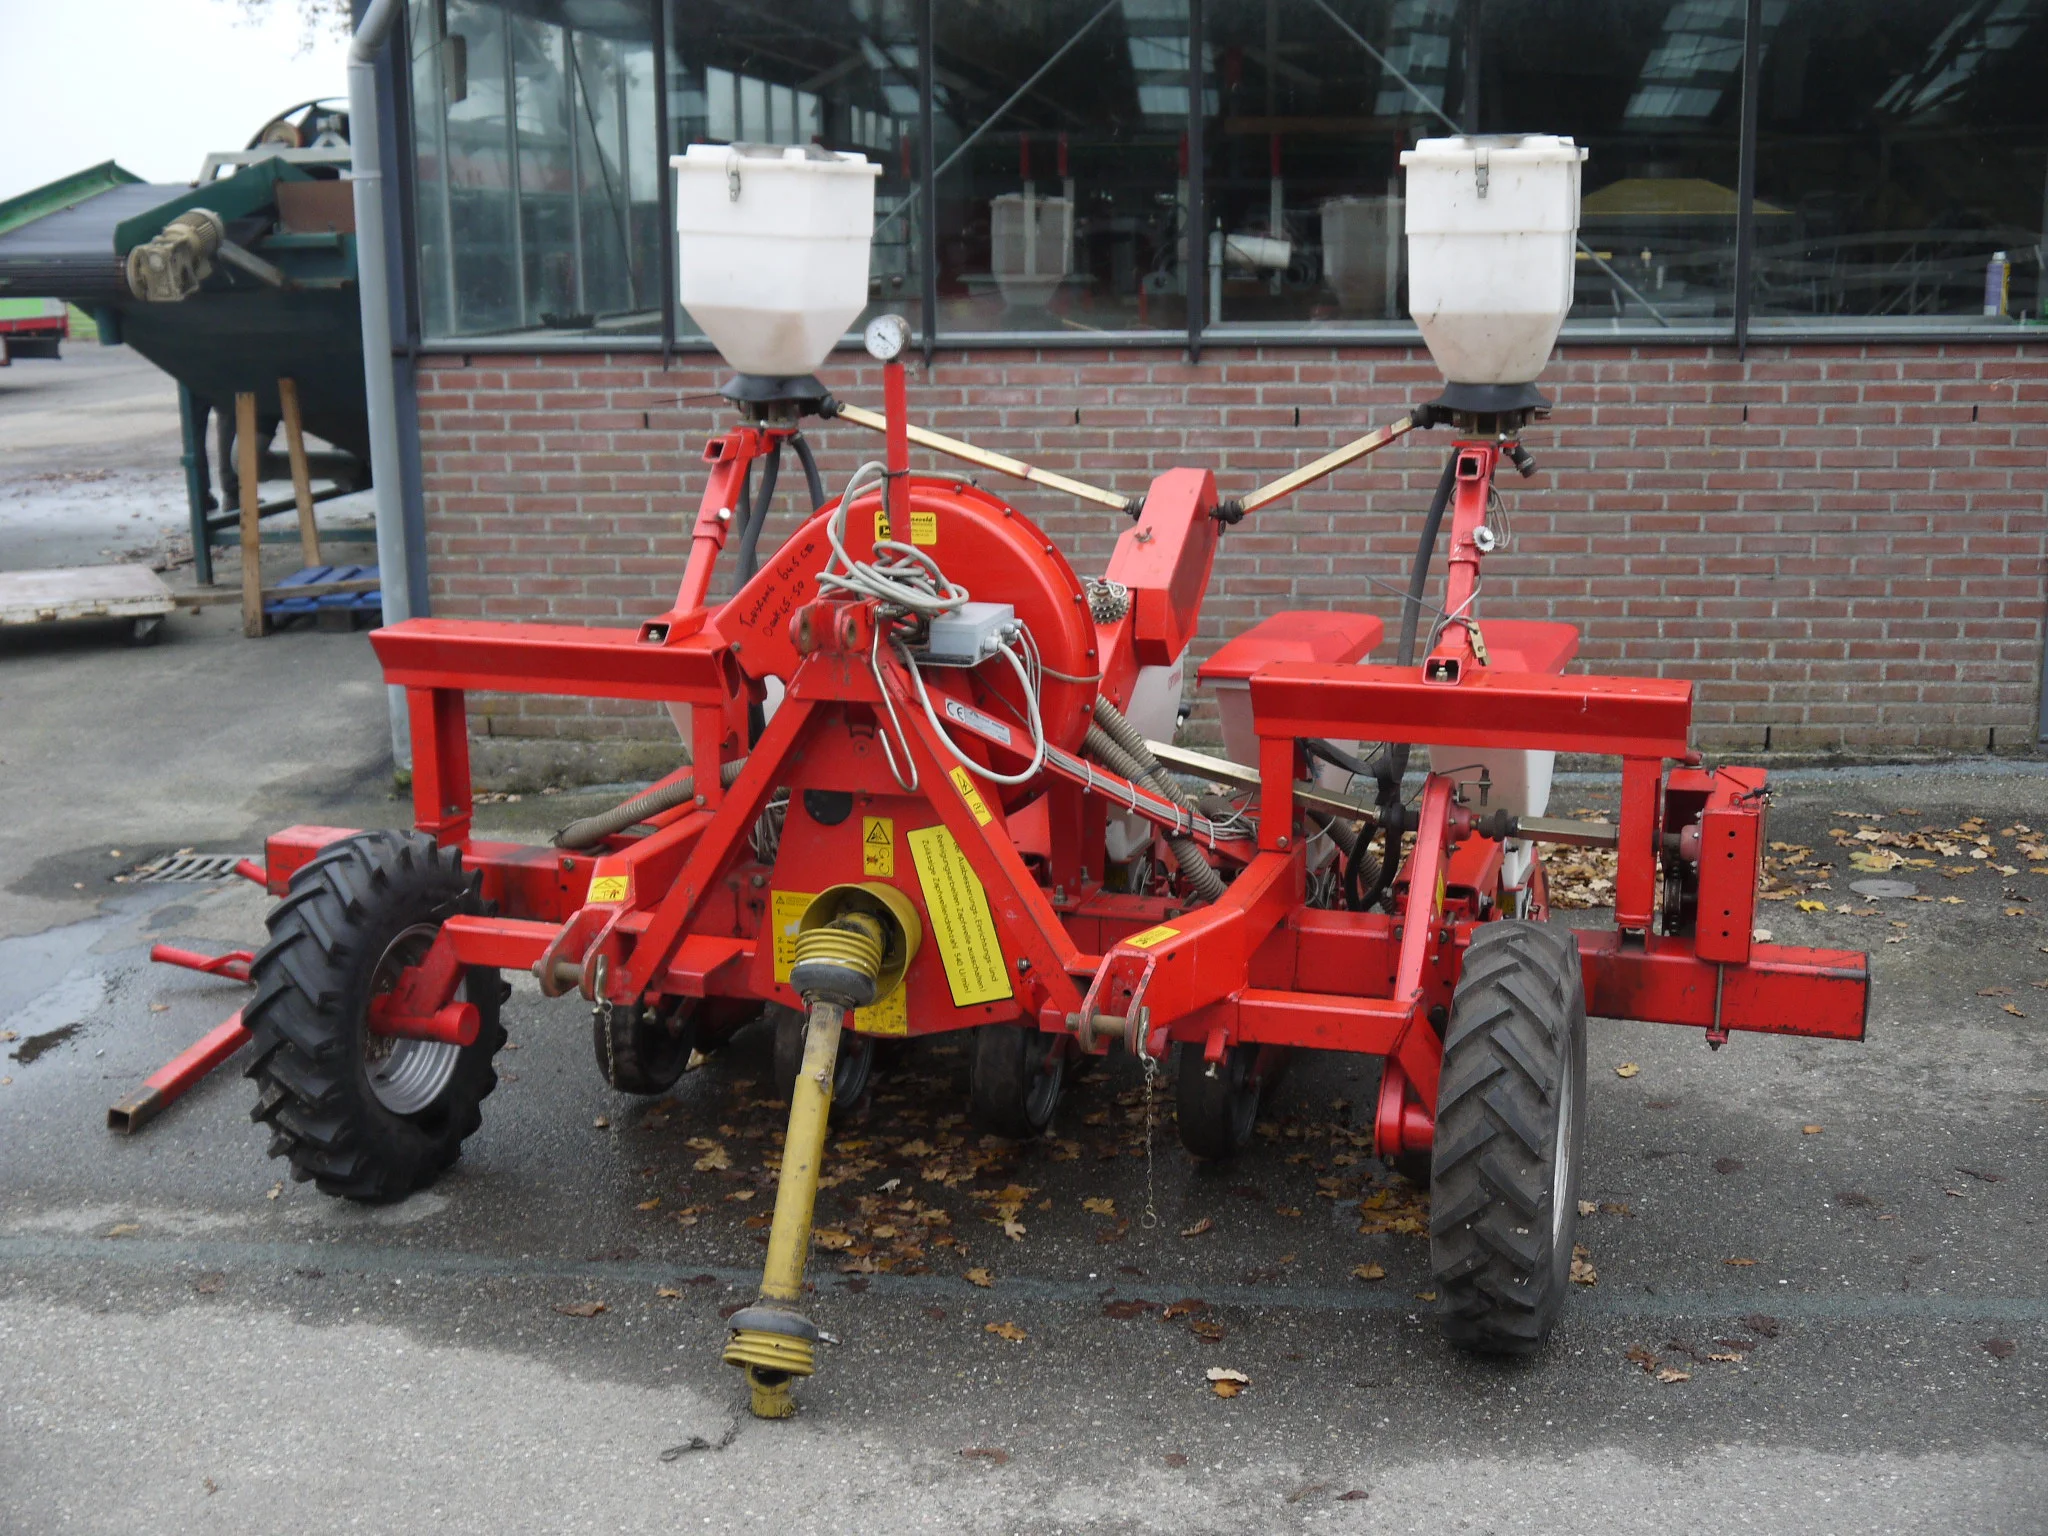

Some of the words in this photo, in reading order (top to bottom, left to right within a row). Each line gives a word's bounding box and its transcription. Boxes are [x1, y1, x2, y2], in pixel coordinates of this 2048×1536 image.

[936, 833, 960, 907] Reinigungsarbeiten
[956, 907, 972, 945] Zapfwelle
[954, 952, 964, 967] 540
